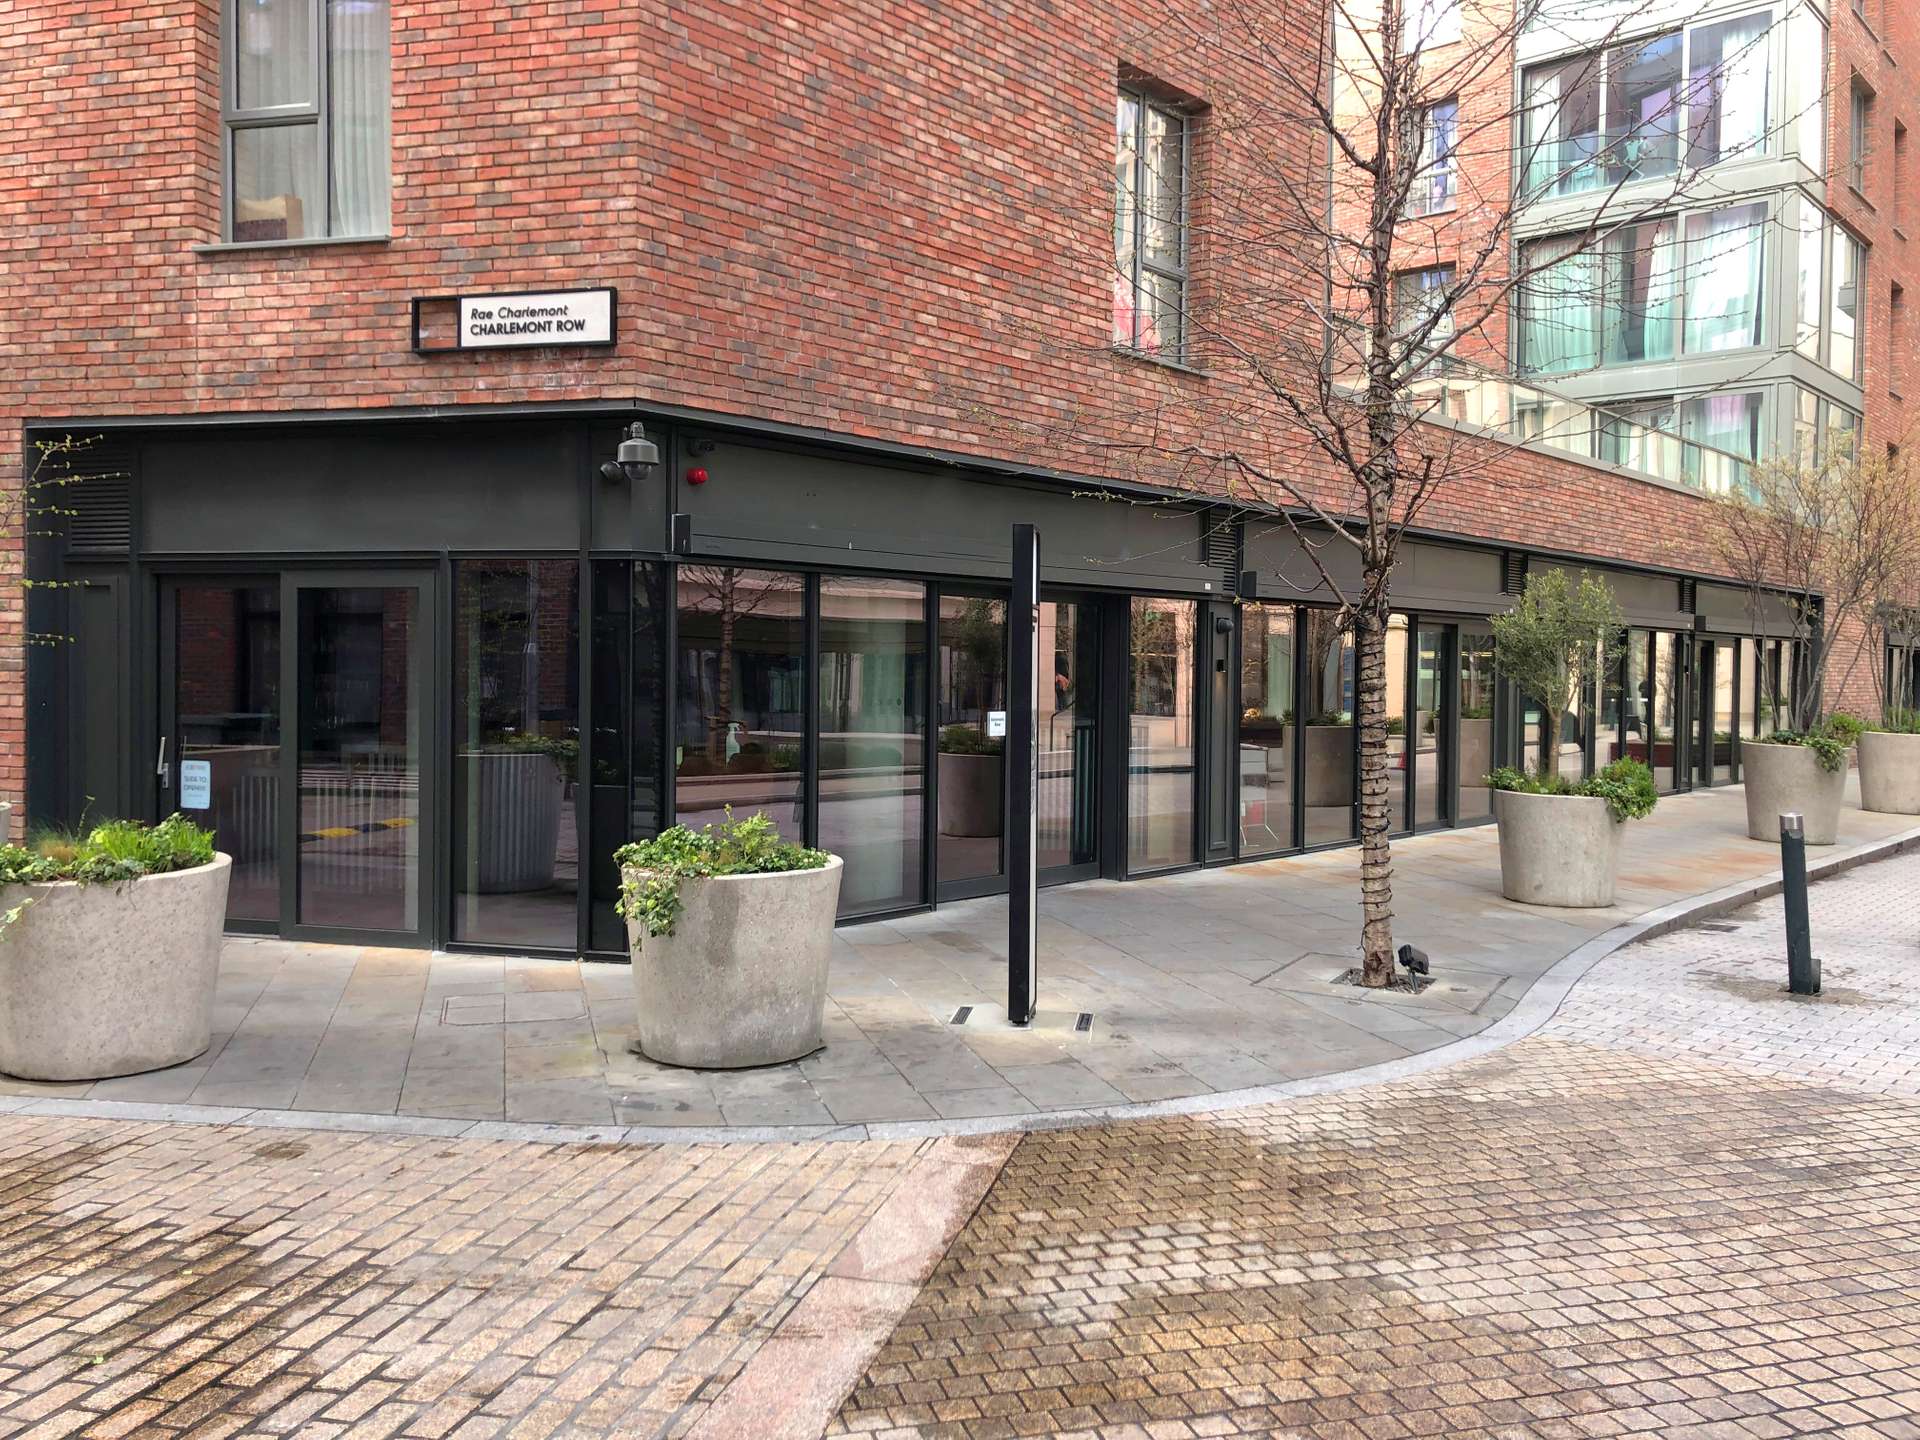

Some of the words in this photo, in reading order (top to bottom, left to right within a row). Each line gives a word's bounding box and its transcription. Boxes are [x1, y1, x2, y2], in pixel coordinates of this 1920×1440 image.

[470, 308, 493, 320] Rae
[498, 304, 569, 319] Charlemont
[470, 320, 553, 336] CHARLEMONT
[556, 318, 586, 332] ROW
